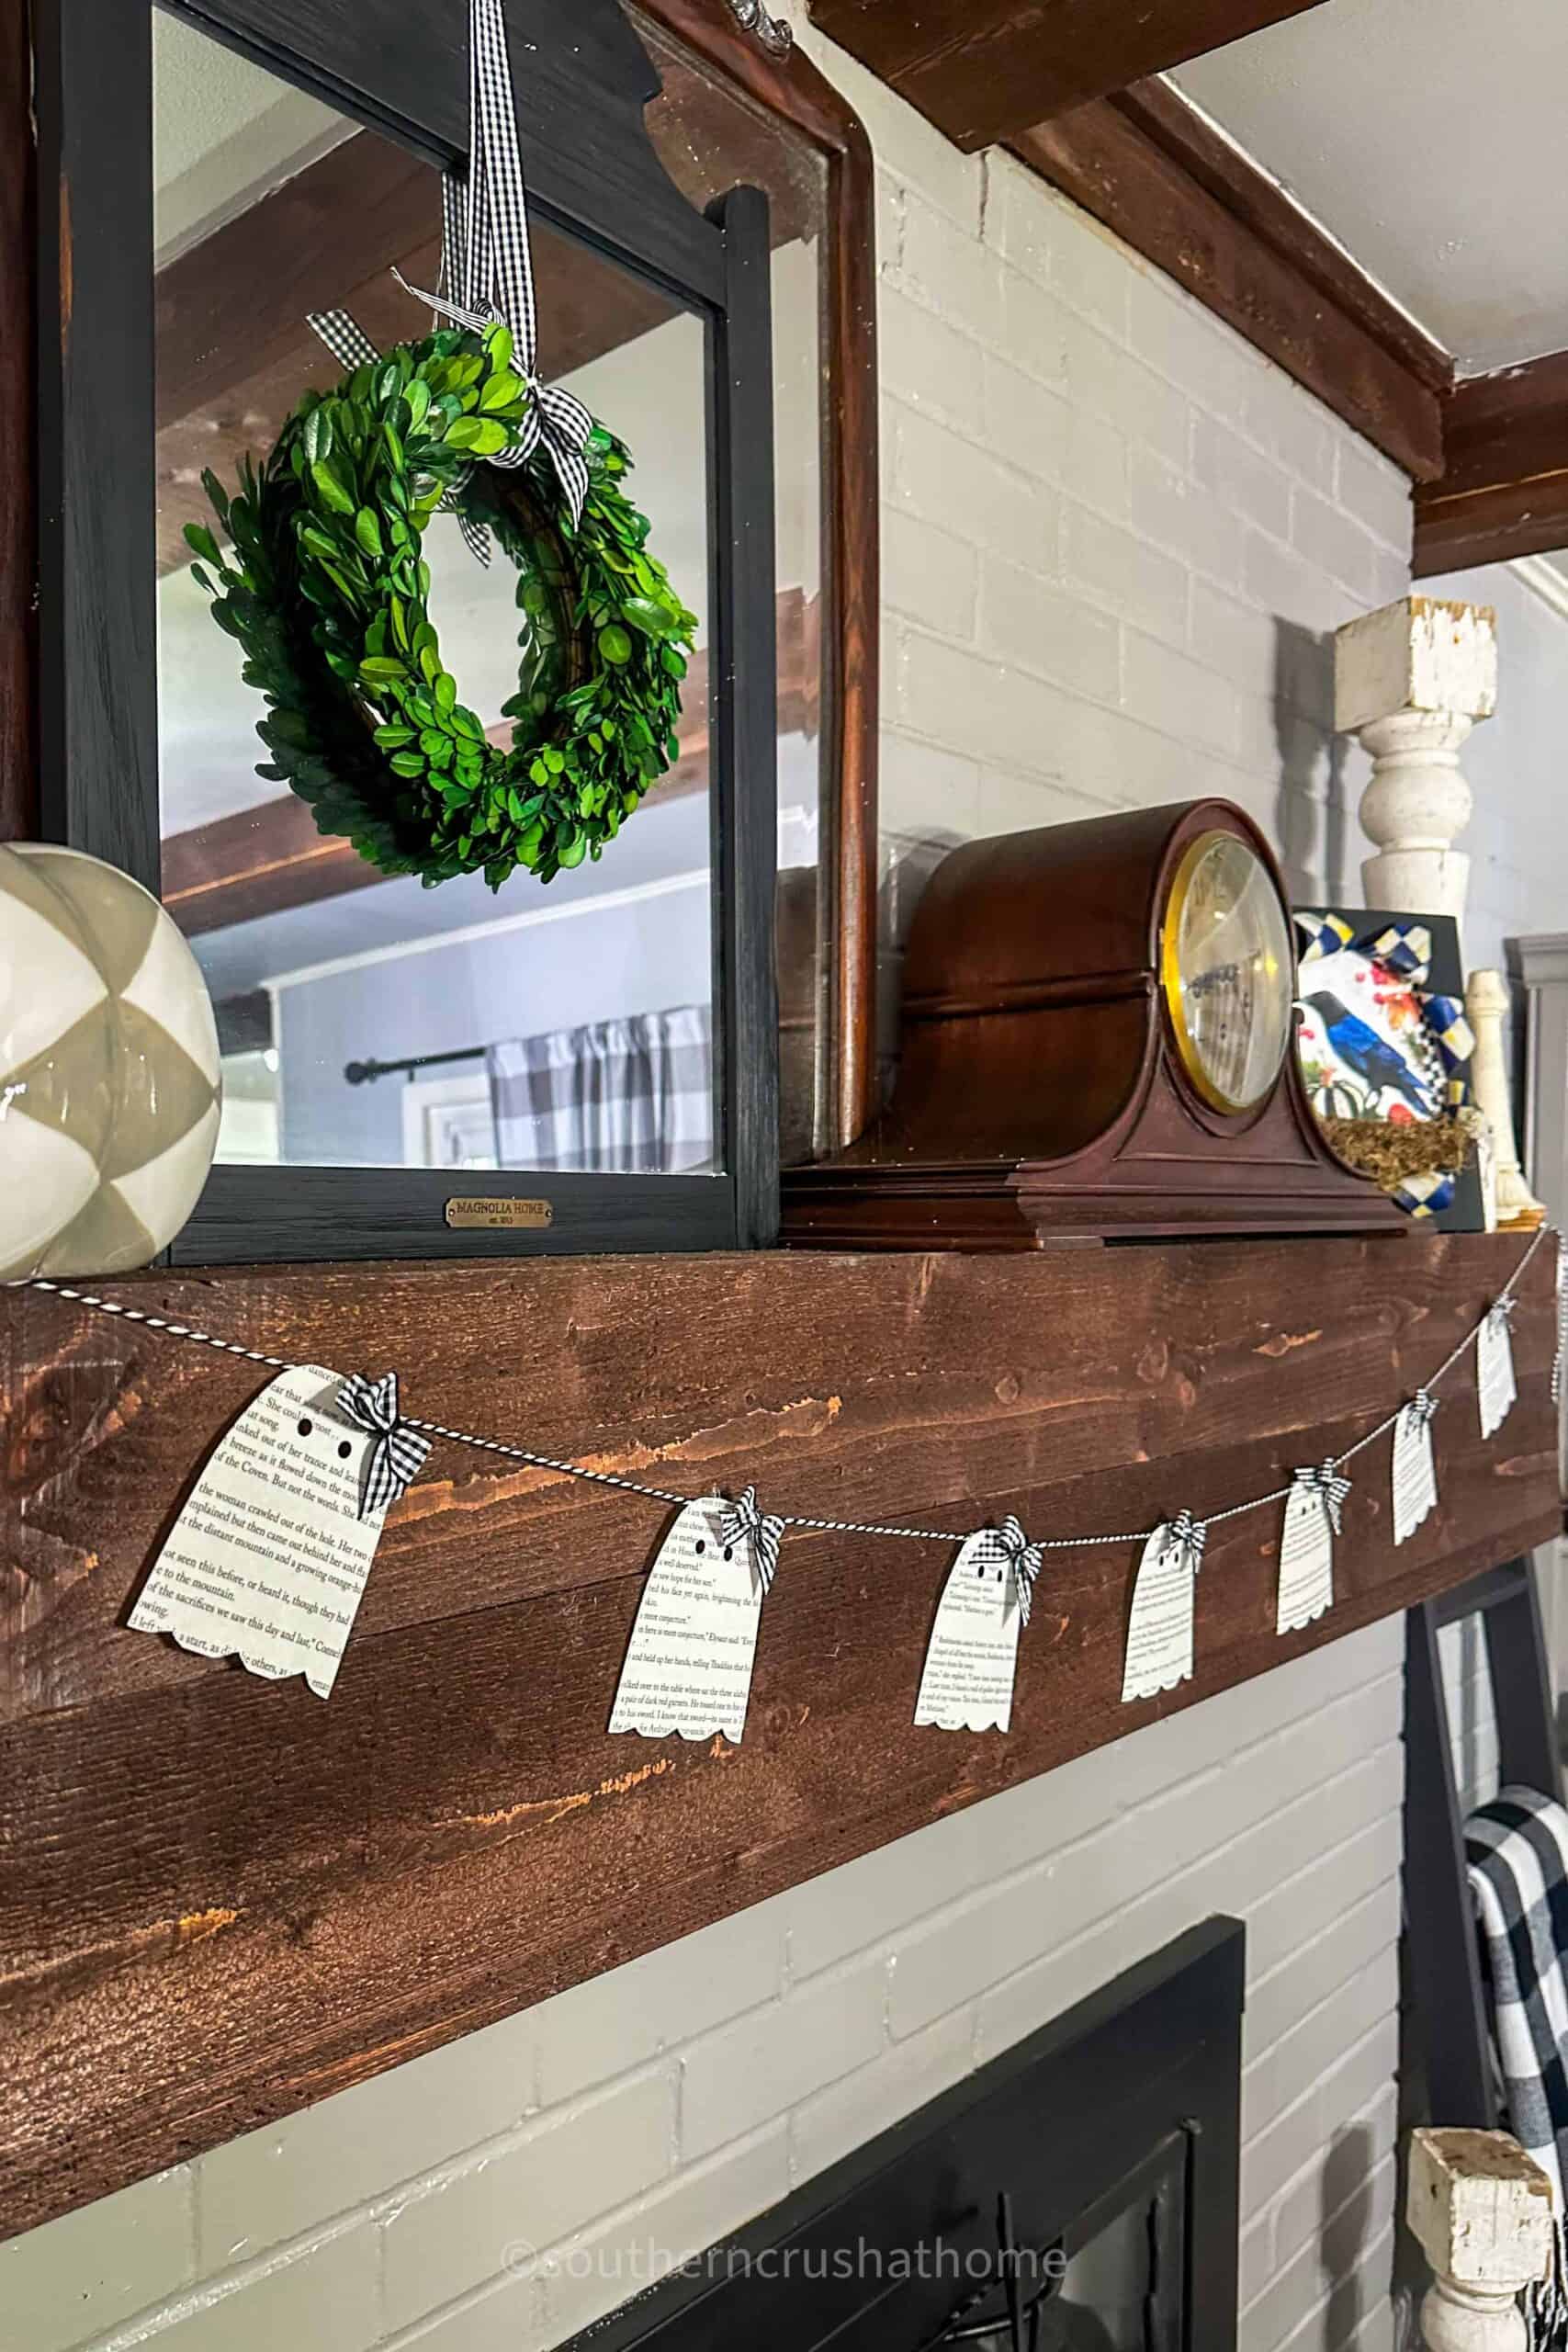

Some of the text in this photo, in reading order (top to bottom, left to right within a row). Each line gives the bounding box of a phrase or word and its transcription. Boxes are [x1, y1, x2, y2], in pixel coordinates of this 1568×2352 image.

[457, 1201, 545, 1215] MAGNOLIA HOME
[265, 1396, 282, 1413] She
[285, 1389, 302, 1403] that
[258, 1416, 279, 1432] song.
[229, 1436, 257, 1457] breeze
[258, 1453, 268, 1462] as
[268, 1454, 277, 1466] it
[277, 1458, 306, 1478] flowed
[305, 1471, 327, 1489] down
[329, 1482, 342, 1495] the
[261, 1435, 276, 1447] out
[276, 1442, 289, 1452] of
[288, 1443, 302, 1459] her
[303, 1453, 328, 1470] trance
[328, 1465, 344, 1477] and
[224, 1455, 240, 1469] the
[241, 1461, 269, 1482] Coven.
[271, 1473, 288, 1489] But
[288, 1485, 302, 1496] not
[302, 1488, 316, 1502] the
[341, 1505, 355, 1520] She
[198, 1482, 367, 1560] the woman crawled out of the hole. Her two
[187, 1516, 203, 1531] the
[203, 1522, 234, 1544] distant
[234, 1537, 274, 1559] mountain
[274, 1554, 292, 1566] and
[295, 1562, 328, 1583] growing
[231, 1513, 246, 1529] but
[246, 1521, 265, 1537] then
[266, 1532, 288, 1545] came
[288, 1541, 303, 1551] out
[302, 1543, 331, 1563] behind
[329, 1554, 343, 1567] her
[342, 1563, 357, 1574] and
[164, 1568, 175, 1578] to
[175, 1570, 191, 1585] the
[191, 1579, 235, 1601] mountain.
[176, 1555, 197, 1568] seen
[198, 1560, 216, 1575] this
[216, 1566, 245, 1588] before,
[247, 1580, 257, 1589] or
[257, 1581, 283, 1599] heard
[291, 1595, 319, 1615] though
[319, 1605, 336, 1623] they
[335, 1611, 351, 1625] had
[158, 1584, 175, 1599] the
[175, 1593, 215, 1613] sacrifices
[217, 1608, 230, 1618] we
[231, 1613, 247, 1623] saw
[247, 1616, 265, 1631] this
[265, 1622, 280, 1639] day
[280, 1631, 297, 1642] and
[186, 1635, 208, 1651] start,
[631, 1653, 643, 1661] and
